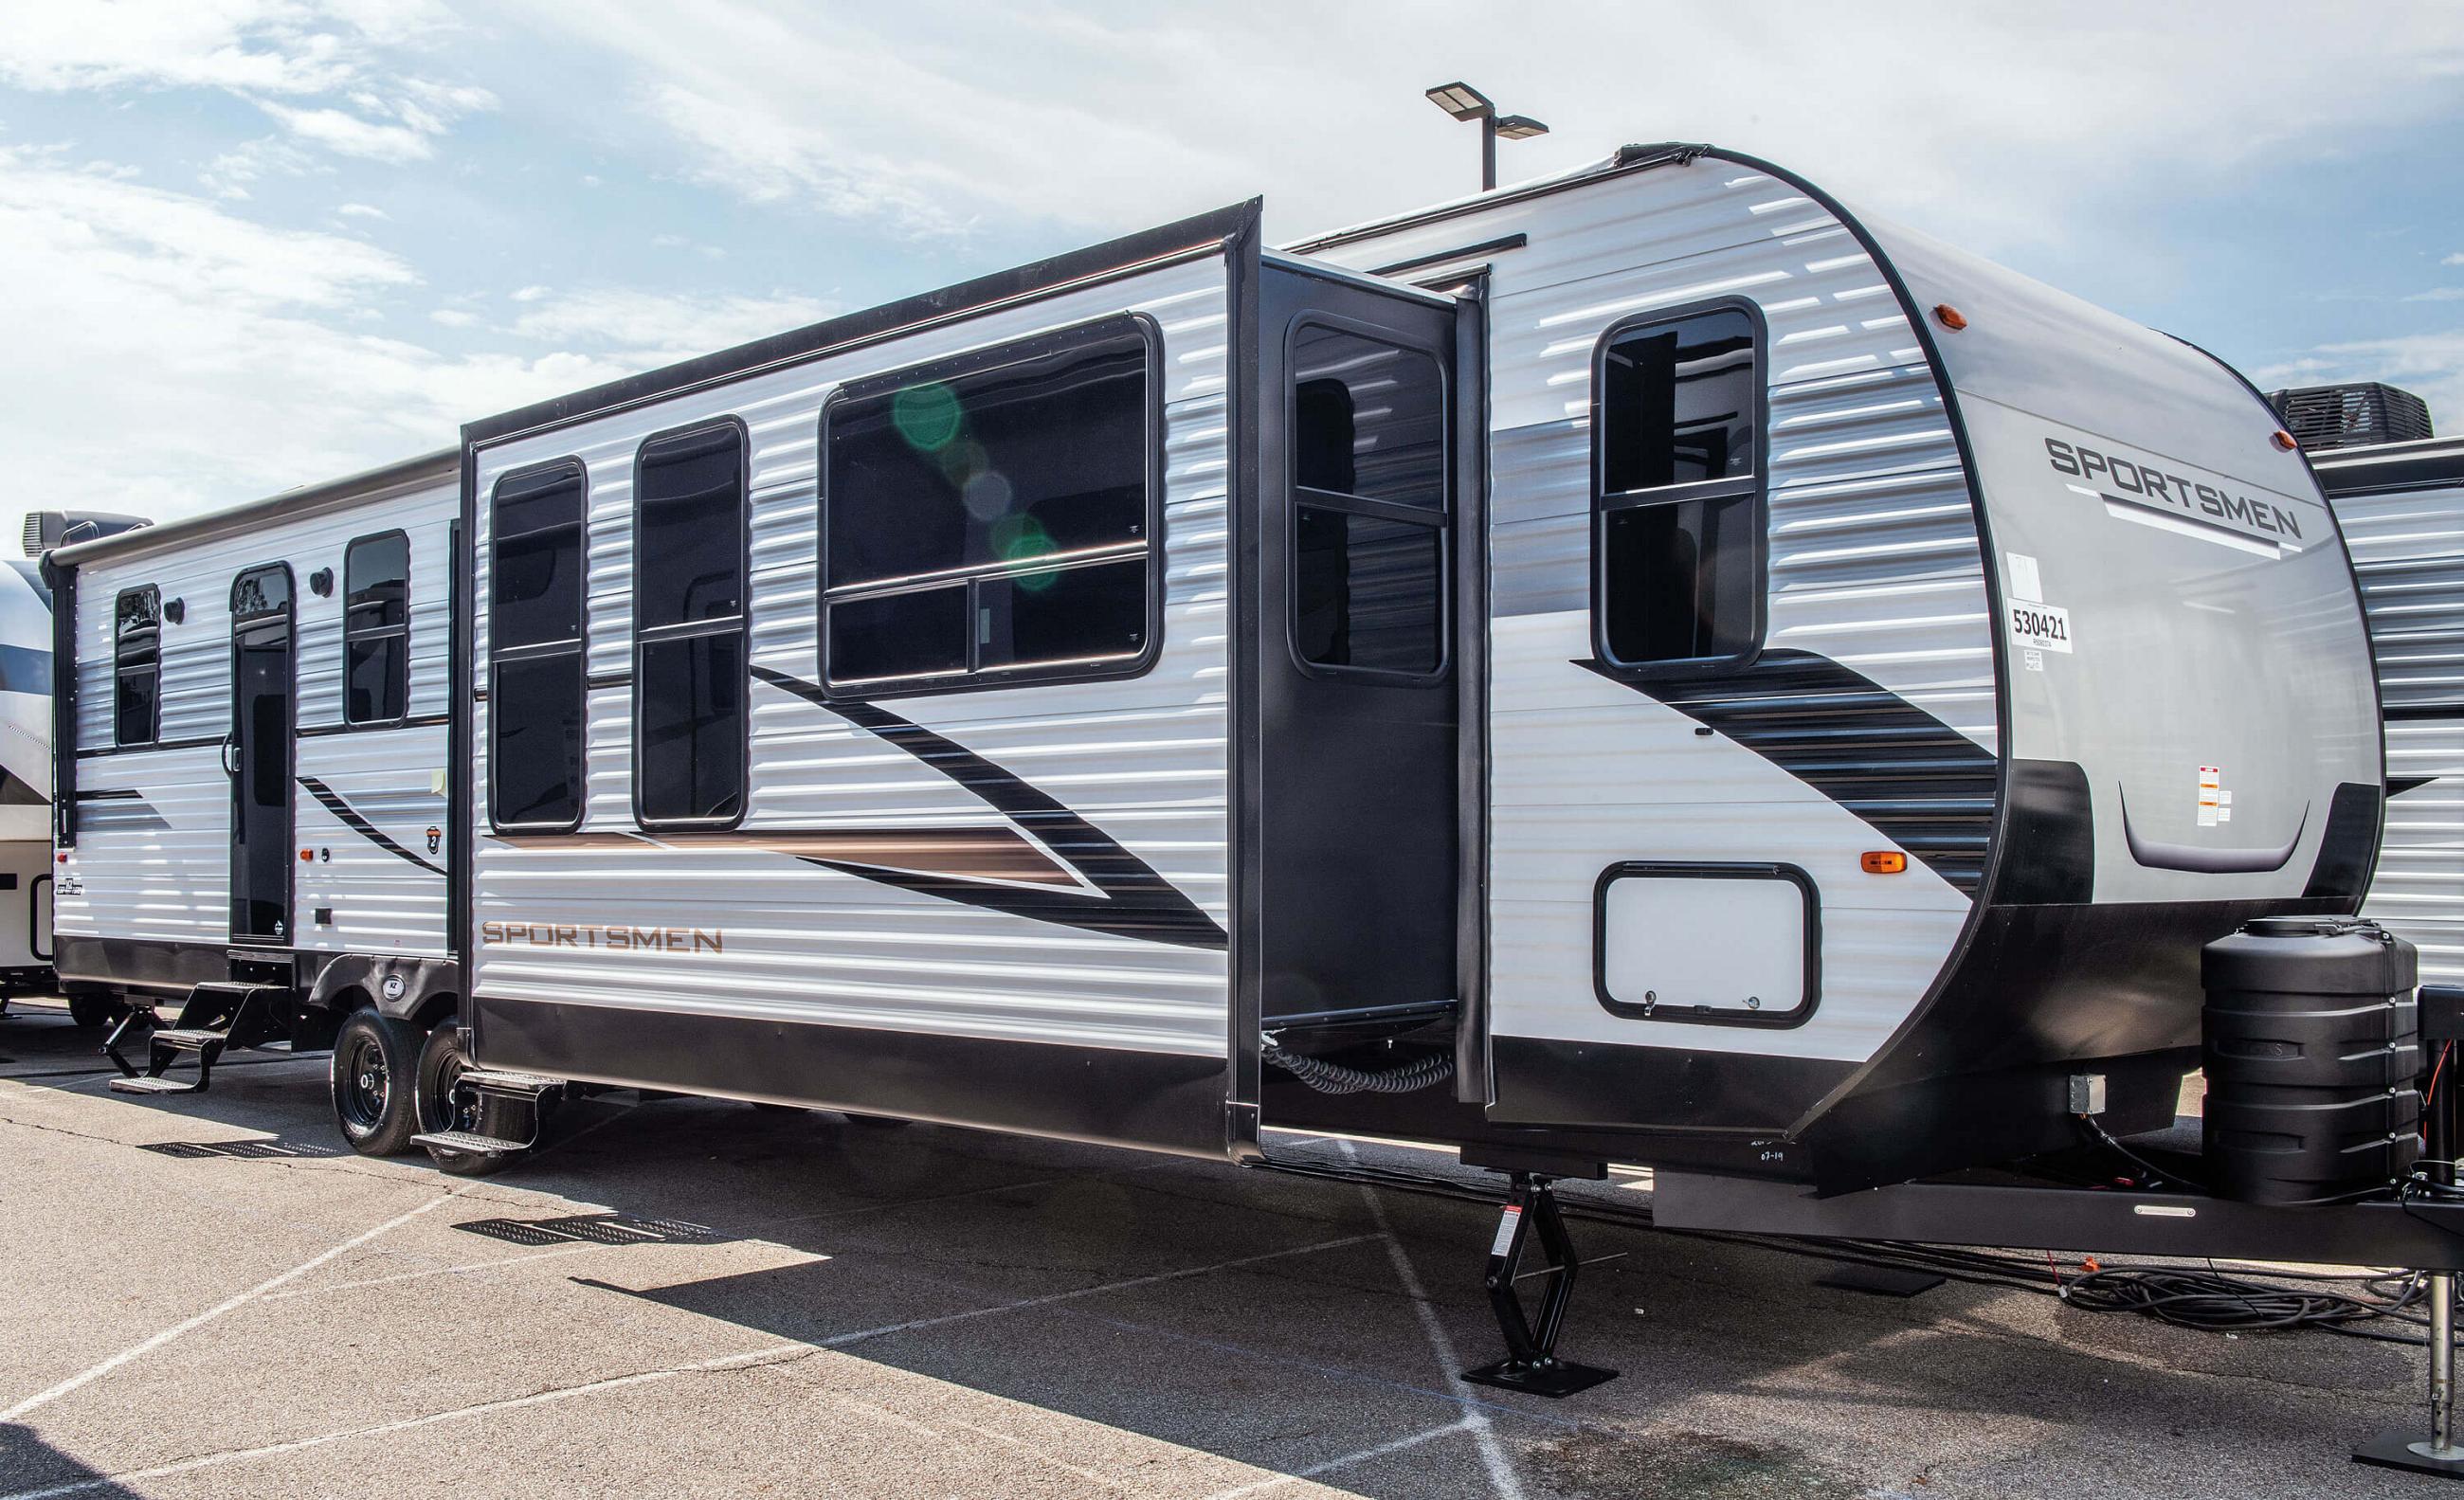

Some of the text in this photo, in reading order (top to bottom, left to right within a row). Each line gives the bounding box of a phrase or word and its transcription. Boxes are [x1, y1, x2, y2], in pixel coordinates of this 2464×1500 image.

[2044, 437, 2302, 540] SPORTSMEN
[2013, 608, 2068, 641] 530421
[482, 921, 723, 955] SPORTSMEN
